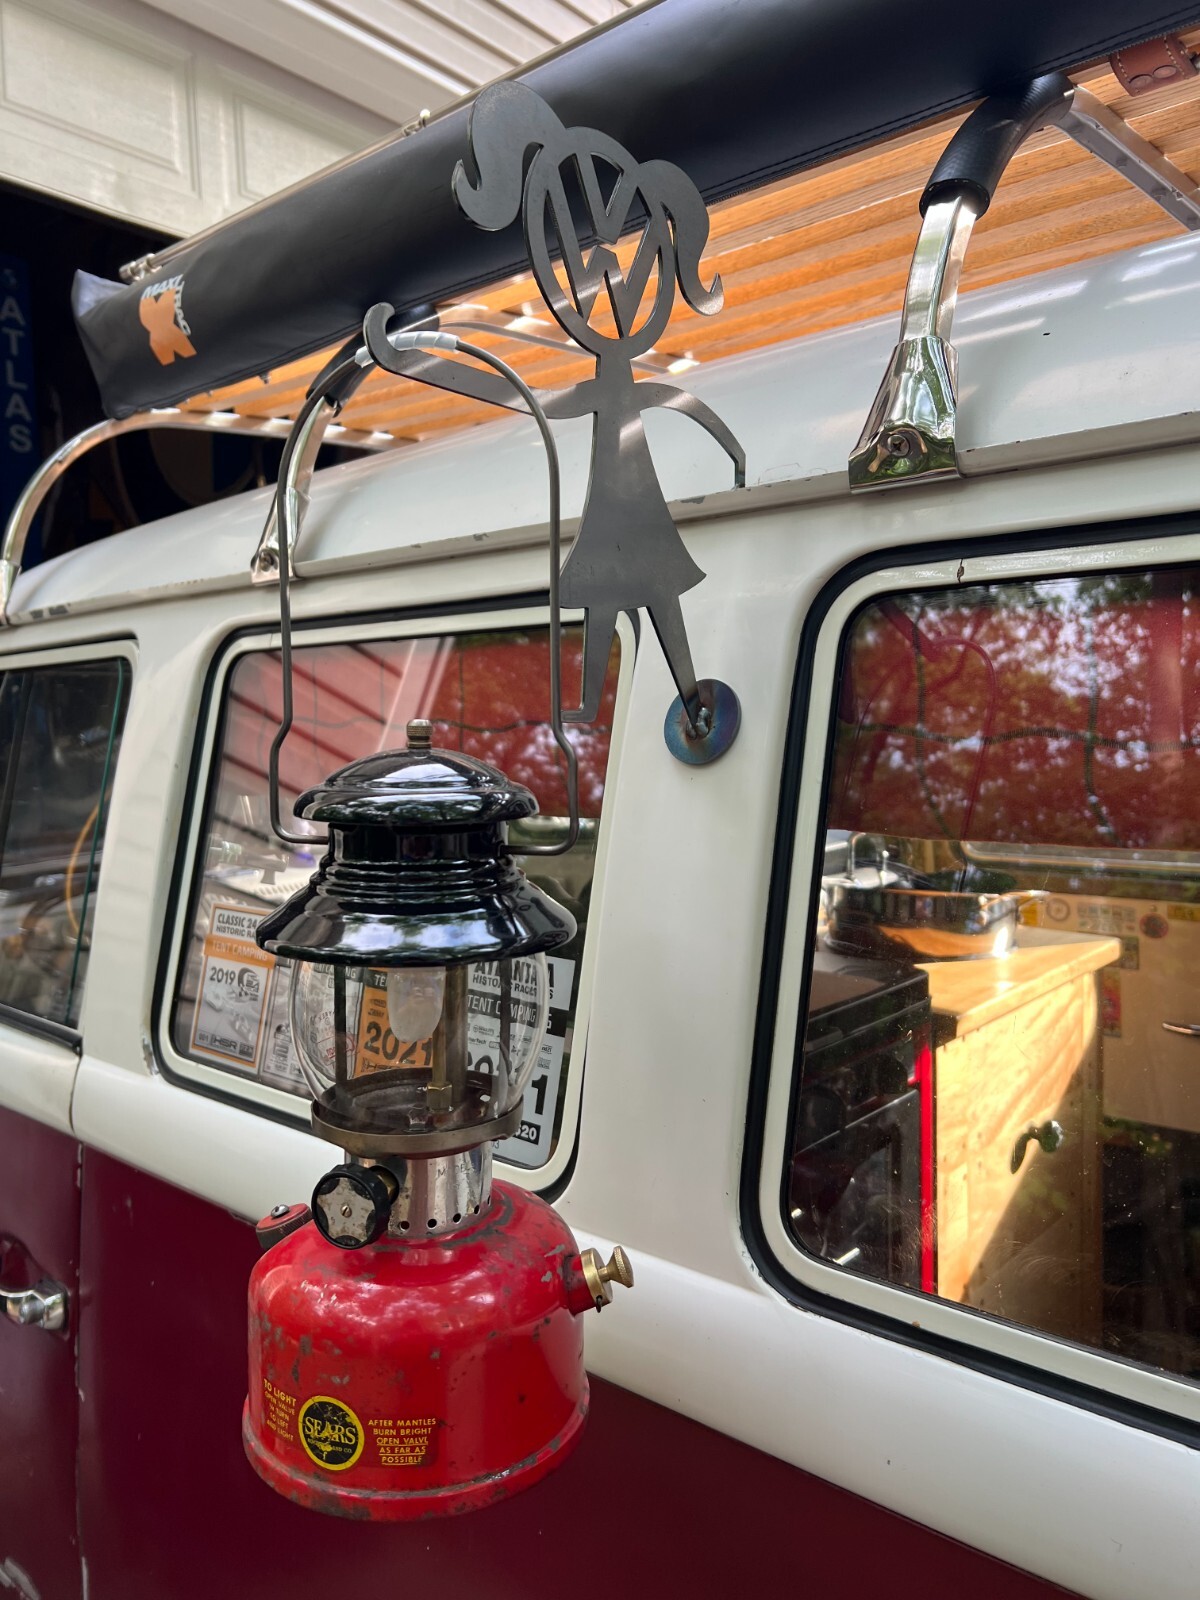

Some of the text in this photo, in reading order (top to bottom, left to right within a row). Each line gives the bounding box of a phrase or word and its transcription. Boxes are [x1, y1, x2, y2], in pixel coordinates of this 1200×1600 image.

[0, 295, 33, 453] ATLAS
[217, 912, 246, 928] CLASSIC
[215, 924, 246, 937] HISTORIC
[214, 941, 267, 961] TENT CAMPING
[209, 966, 237, 986] 2019
[468, 995, 494, 1013] TENT
[264, 1378, 296, 1407] TO LIGHT
[304, 1416, 356, 1445] SEARS
[368, 1418, 436, 1427] AFTER MANTLES
[400, 1427, 431, 1436] BRIGHT
[414, 1445, 426, 1453] AS
